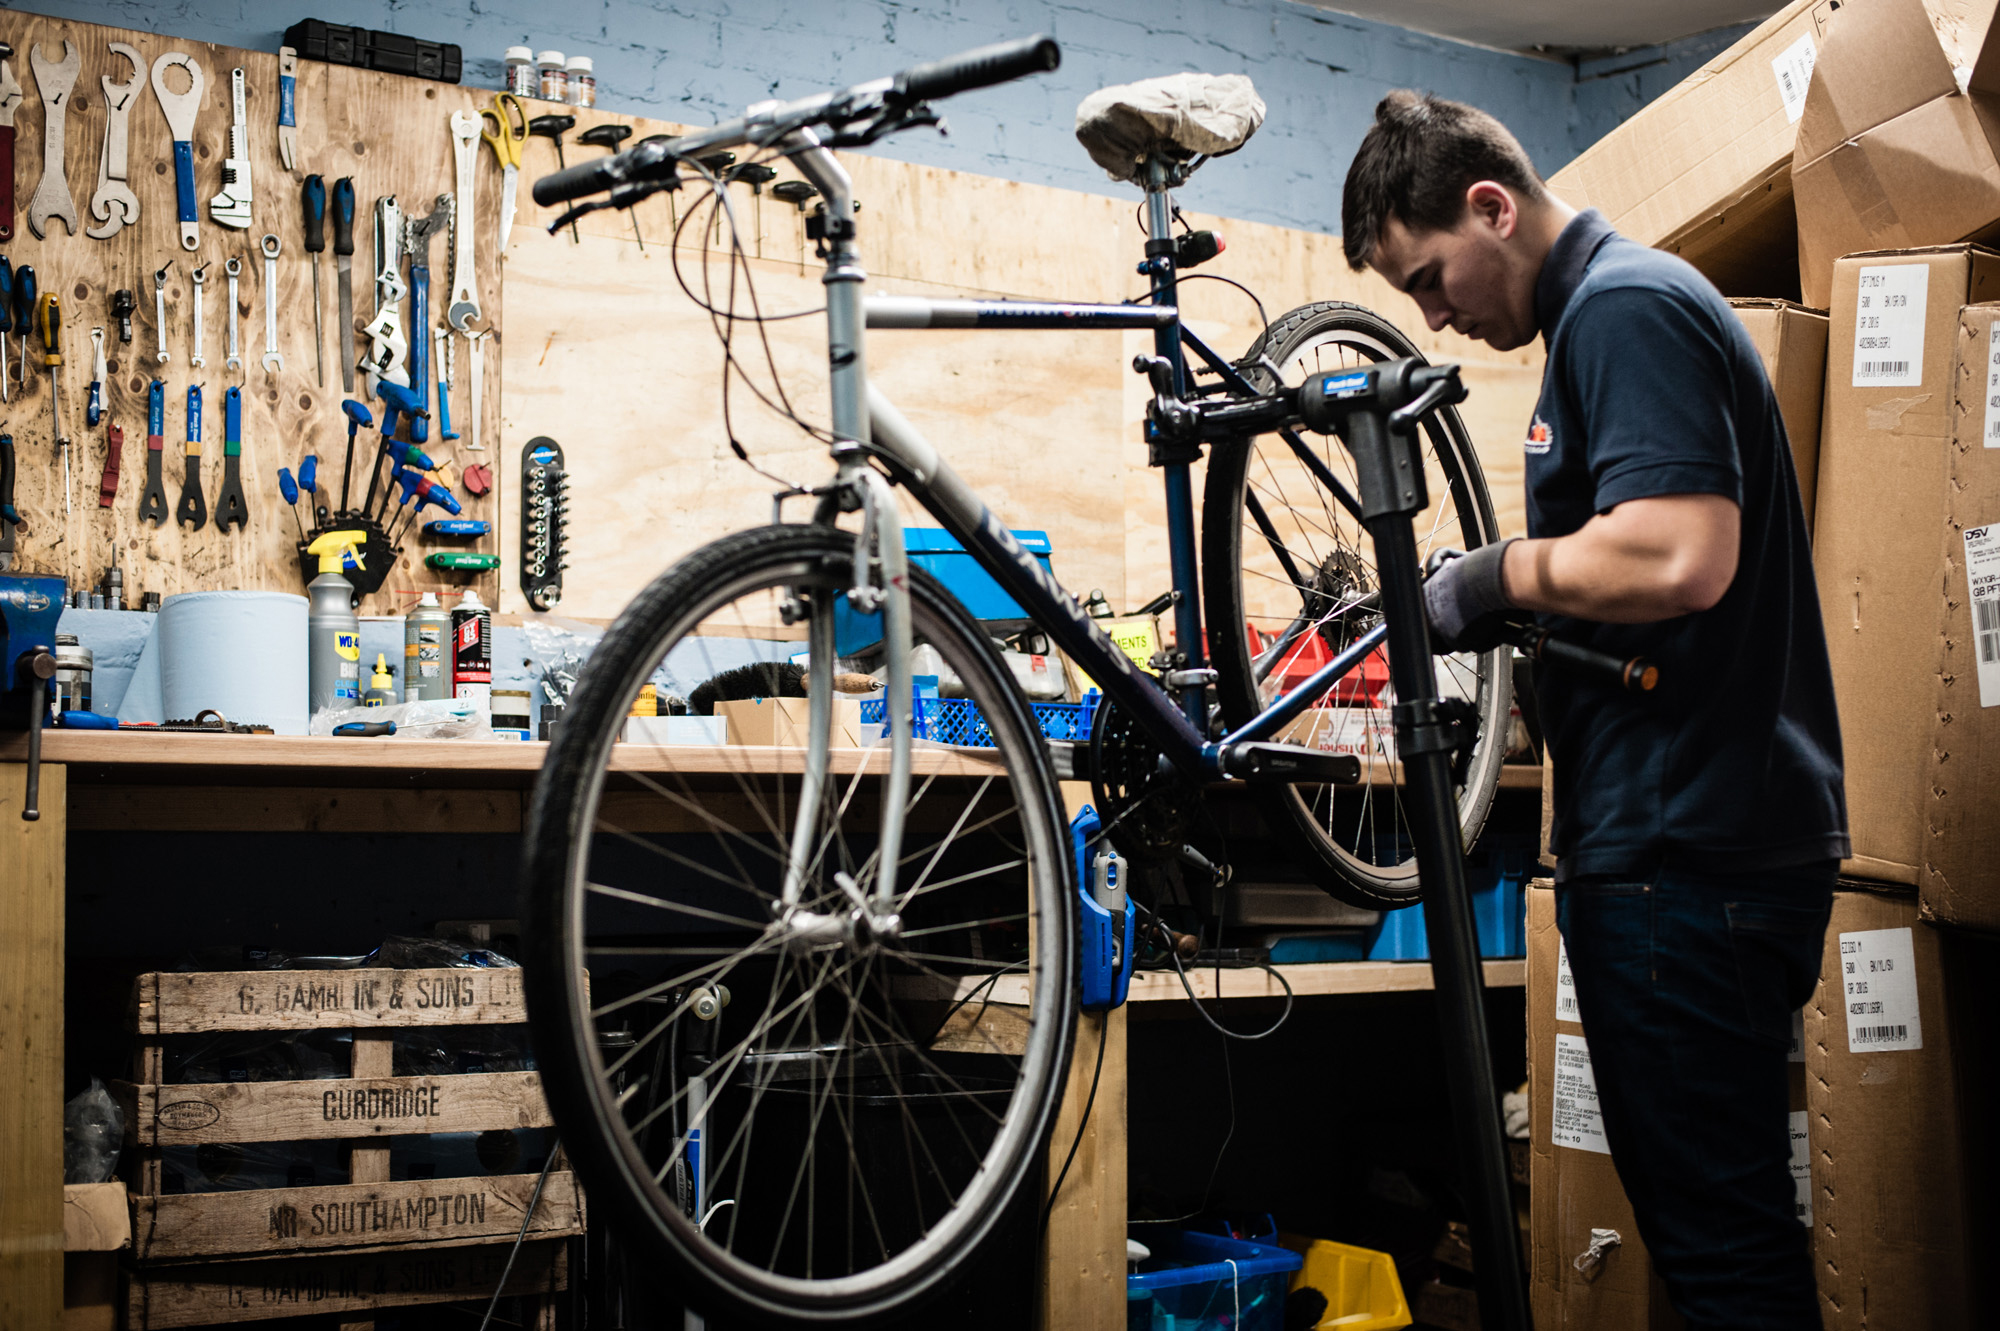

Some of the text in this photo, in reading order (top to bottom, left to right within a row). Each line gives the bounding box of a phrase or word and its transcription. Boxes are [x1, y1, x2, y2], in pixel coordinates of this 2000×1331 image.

[1965, 527, 1989, 540] DSV
[987, 511, 1132, 676] DAWES
[1973, 586, 1986, 597] GB
[338, 635, 360, 648] WD-4
[1112, 635, 1147, 650] MENTS
[341, 662, 359, 678] BIK
[1845, 962, 1855, 974] 500
[388, 978, 404, 1011] &
[416, 976, 476, 1010] SONS
[1848, 982, 1854, 994] GR
[322, 1086, 441, 1121] CURDRIDGE
[1572, 1135, 1581, 1143] 10
[311, 1192, 486, 1236] SOUTHAMPTON
